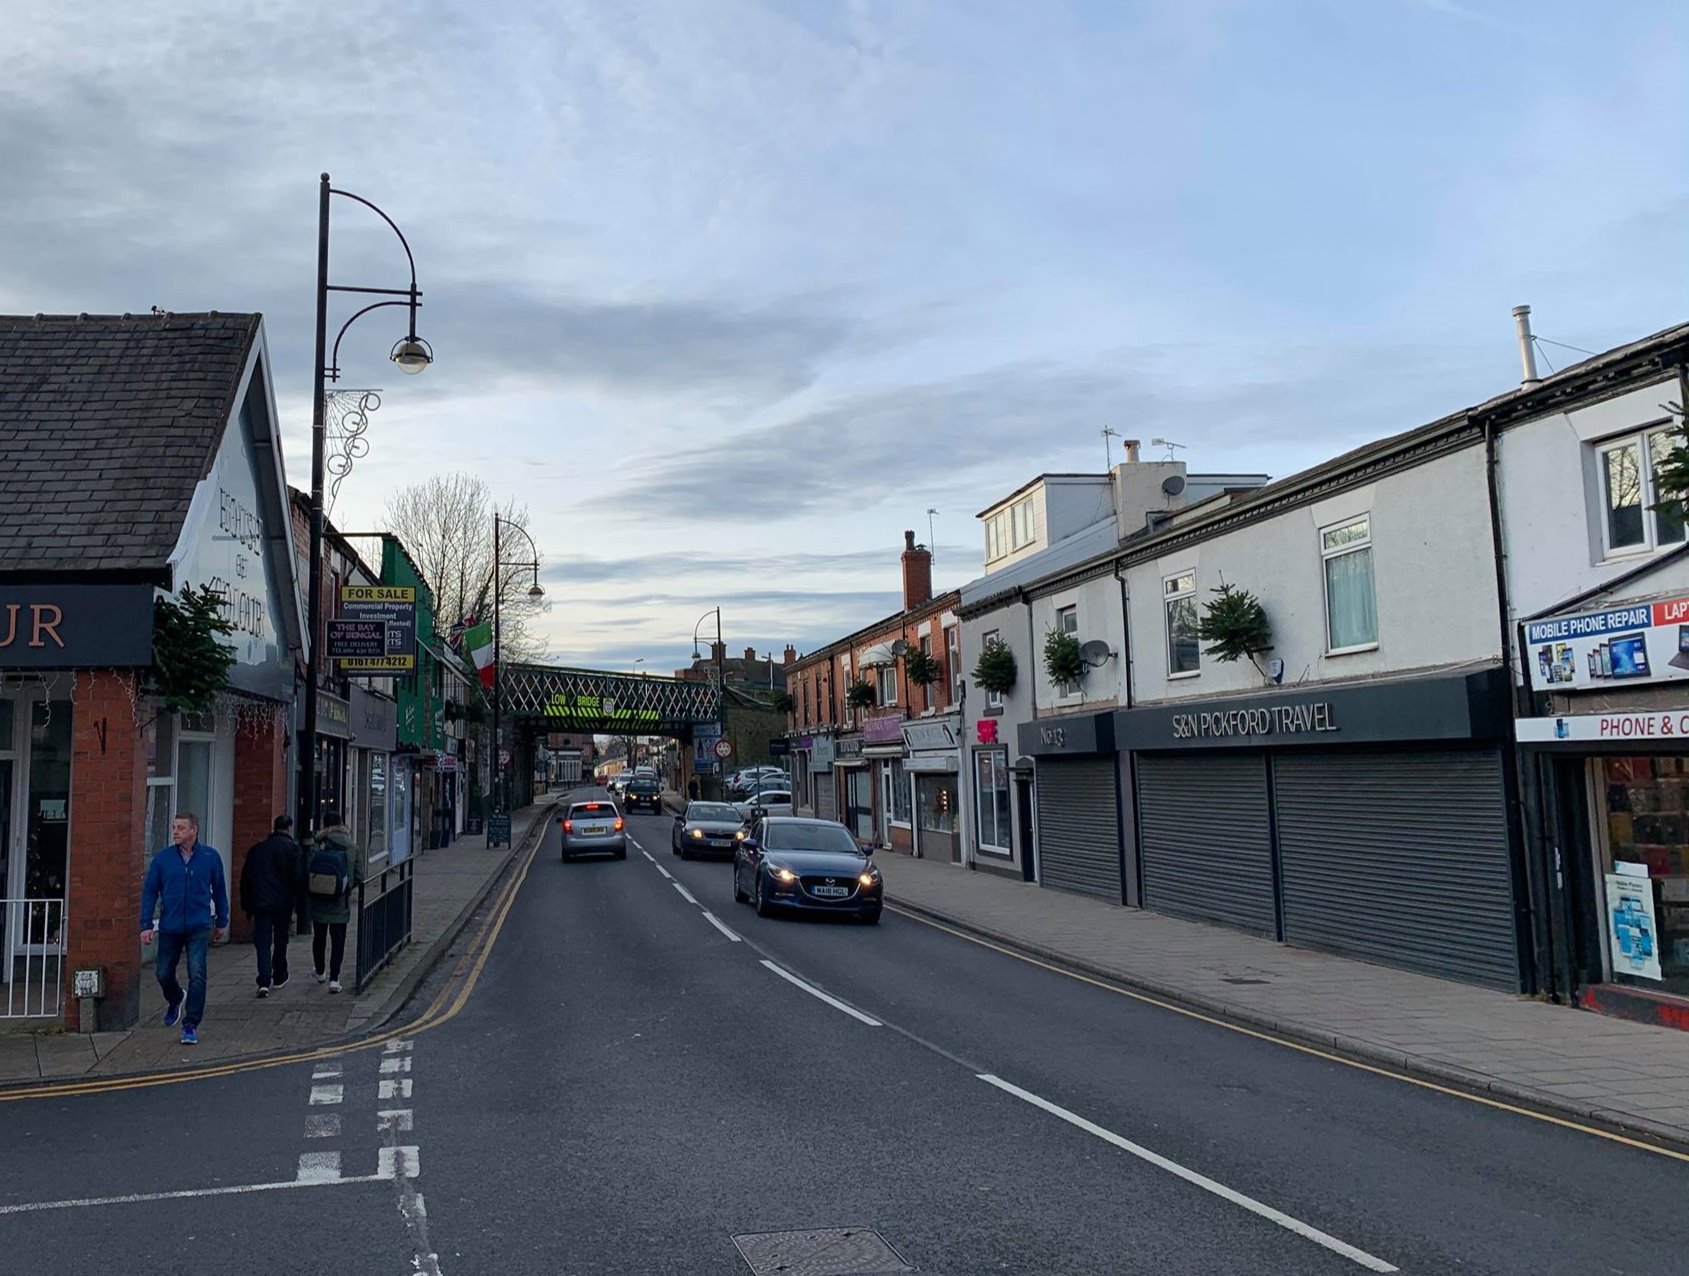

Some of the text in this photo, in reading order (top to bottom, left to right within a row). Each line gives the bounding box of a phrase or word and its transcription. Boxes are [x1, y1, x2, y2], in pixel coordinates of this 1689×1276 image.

[348, 589, 409, 599] FOR SALE
[343, 602, 412, 611] Commercial Property
[1664, 601, 1689, 620] LAP
[360, 612, 397, 620] Investment
[336, 623, 376, 631] THE BAY
[1532, 608, 1648, 640] MOBILE PHONE REPAIR
[551, 694, 566, 705] LOW
[577, 695, 600, 707] BRIDGE
[1172, 702, 1337, 738] S&N PICKFORD TRAVEL
[1600, 717, 1655, 737] PHONE
[1661, 715, 1674, 735] &
